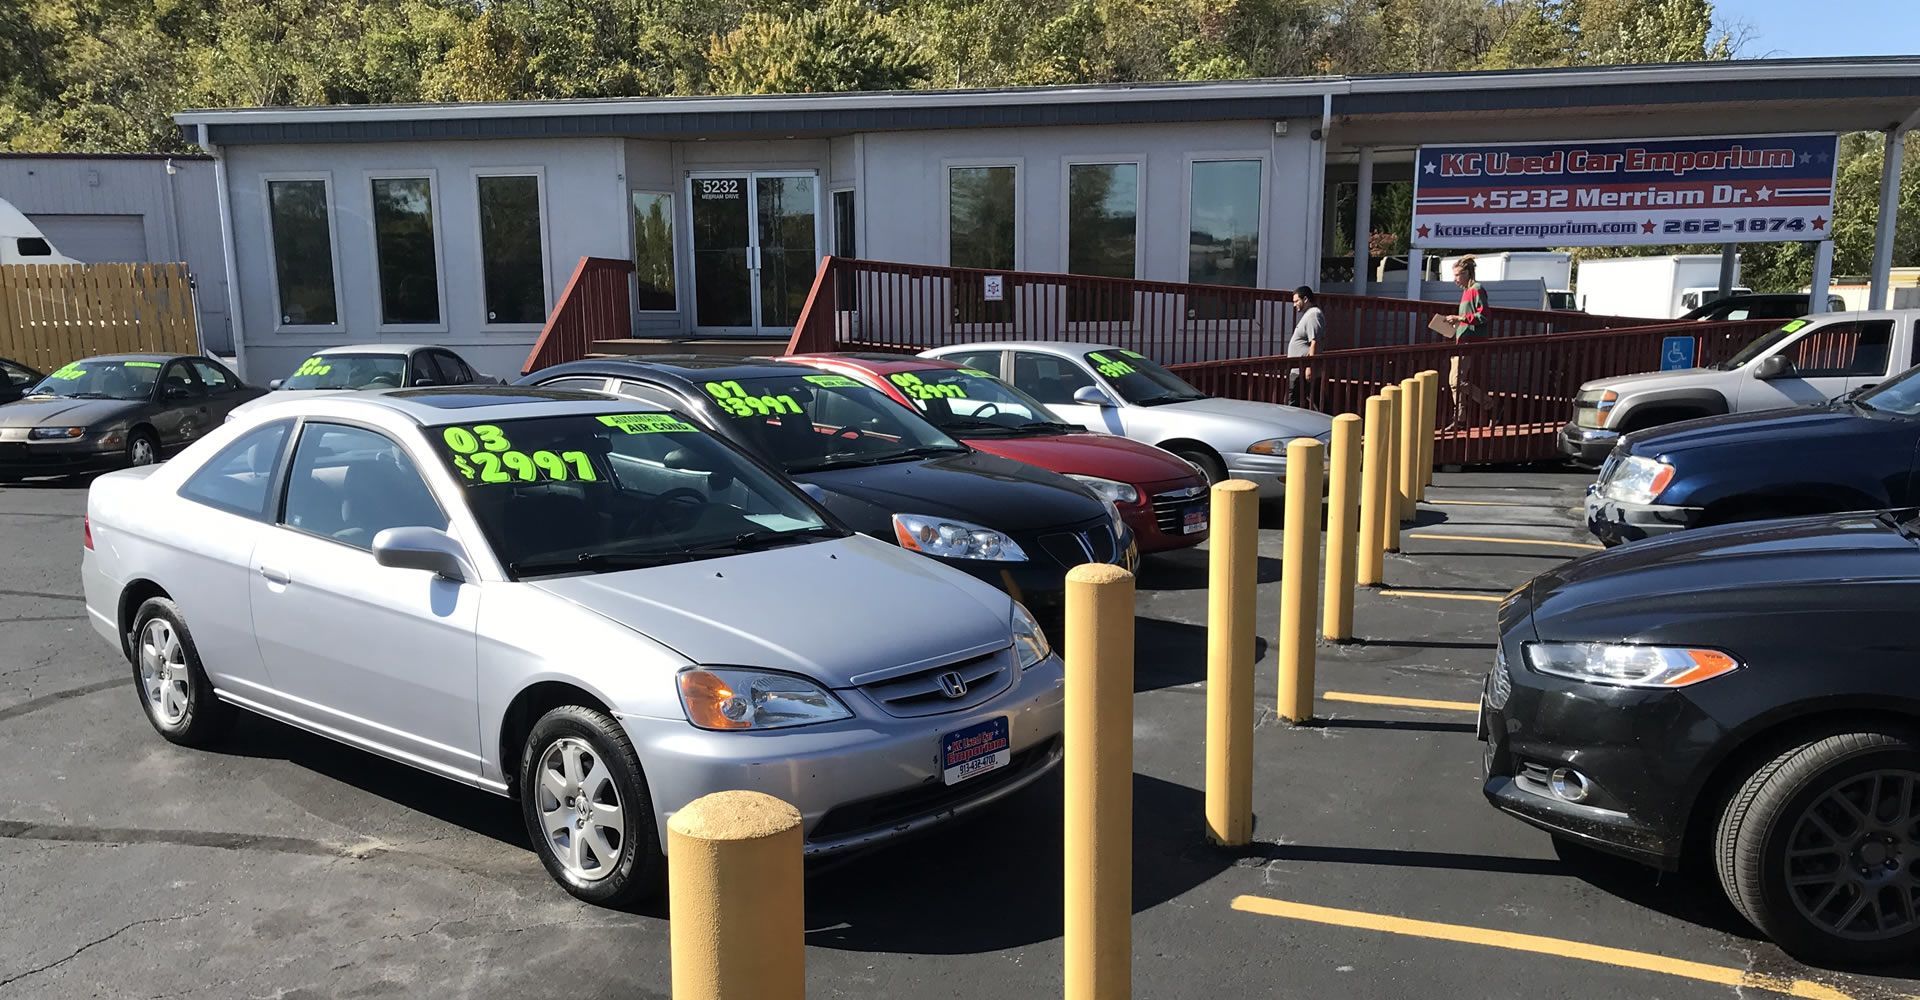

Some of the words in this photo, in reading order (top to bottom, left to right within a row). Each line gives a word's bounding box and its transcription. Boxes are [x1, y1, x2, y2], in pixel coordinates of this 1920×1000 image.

[1440, 153, 1481, 177] KC
[1485, 151, 1564, 175] Used
[1567, 150, 1624, 174] Car
[1624, 145, 1795, 176] Emporium
[703, 180, 738, 193] 5232
[1489, 189, 1569, 209] 5232
[1575, 187, 1705, 207] Merriam
[1712, 185, 1753, 204] Dr.
[1434, 220, 1638, 239] kcusedcaremporium.com
[1663, 217, 1807, 234] 262-1874
[705, 380, 749, 399] 07
[904, 384, 968, 400] $2997
[717, 395, 804, 417] $3997
[443, 425, 511, 453] 03
[626, 423, 650, 433] AIR
[454, 451, 597, 483] $2997
